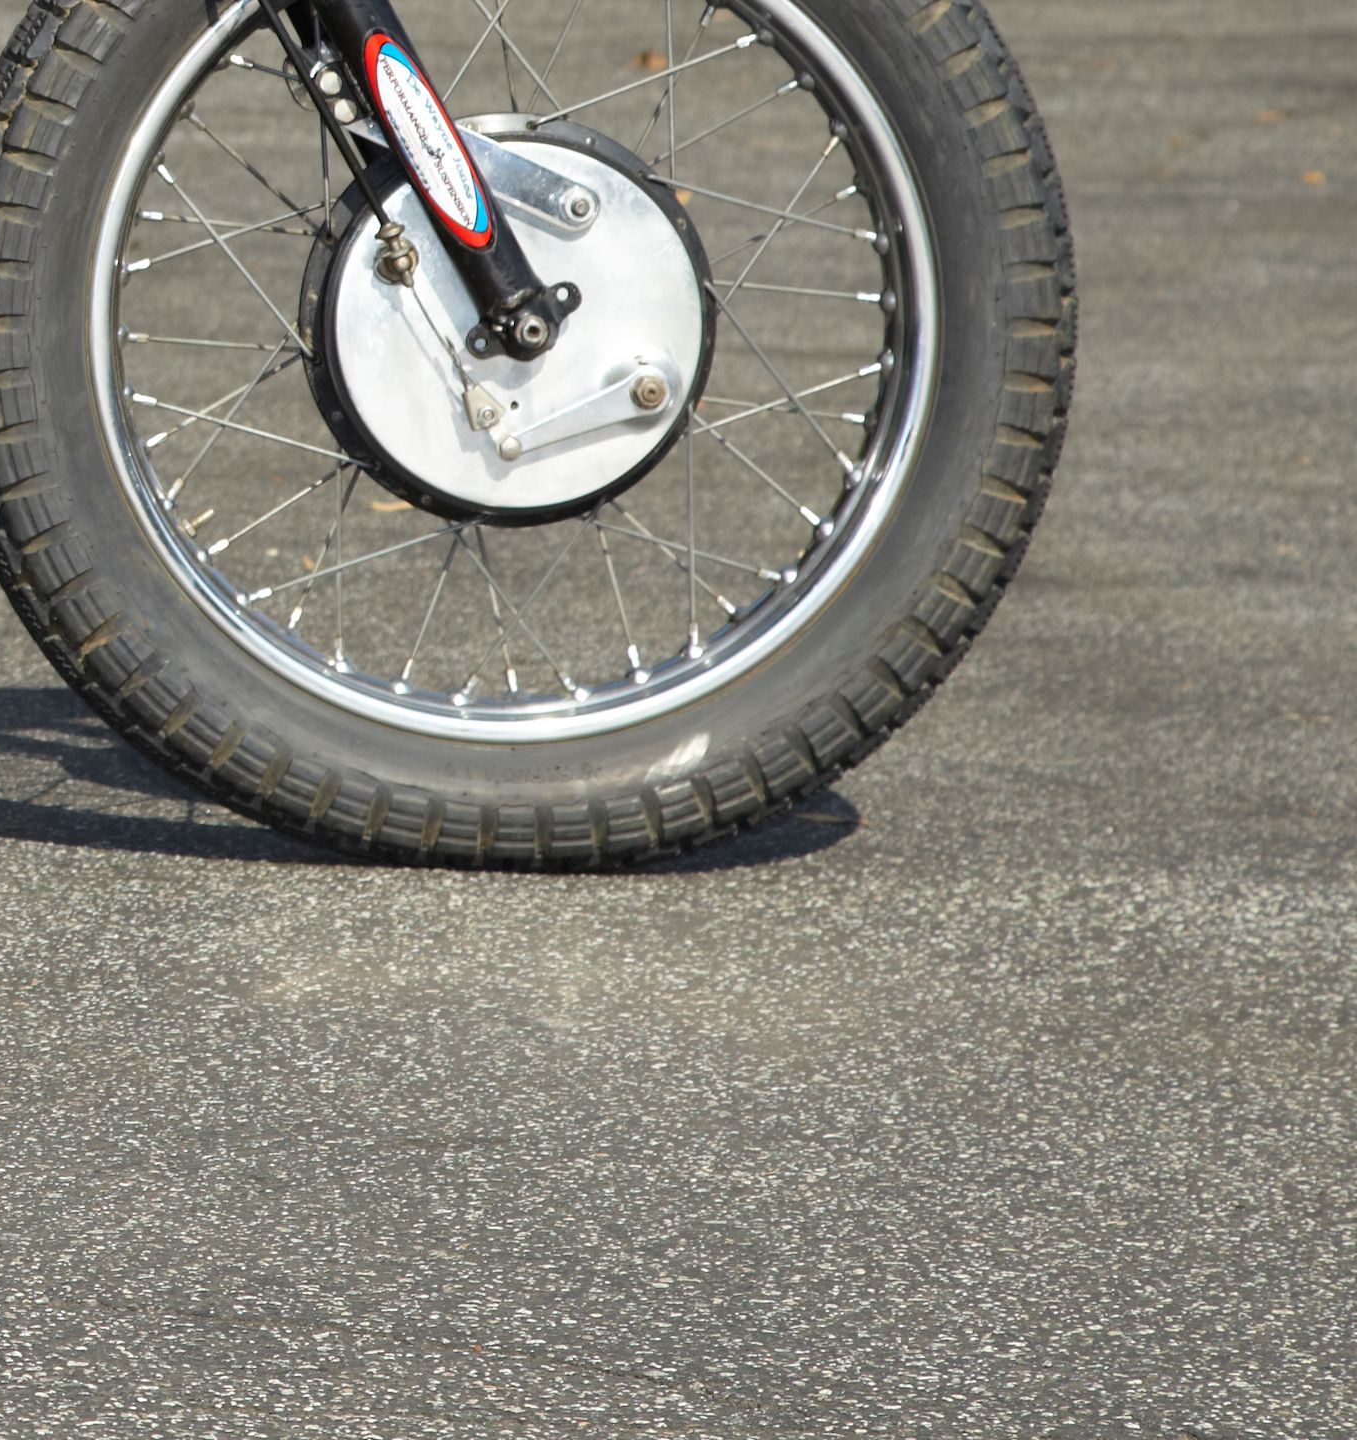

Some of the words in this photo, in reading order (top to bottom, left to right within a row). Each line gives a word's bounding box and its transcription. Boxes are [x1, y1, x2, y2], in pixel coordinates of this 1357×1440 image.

[379, 56, 428, 141] PERFORMANCE
[434, 159, 473, 228] SUSPENSION
[453, 156, 474, 200] Jones
